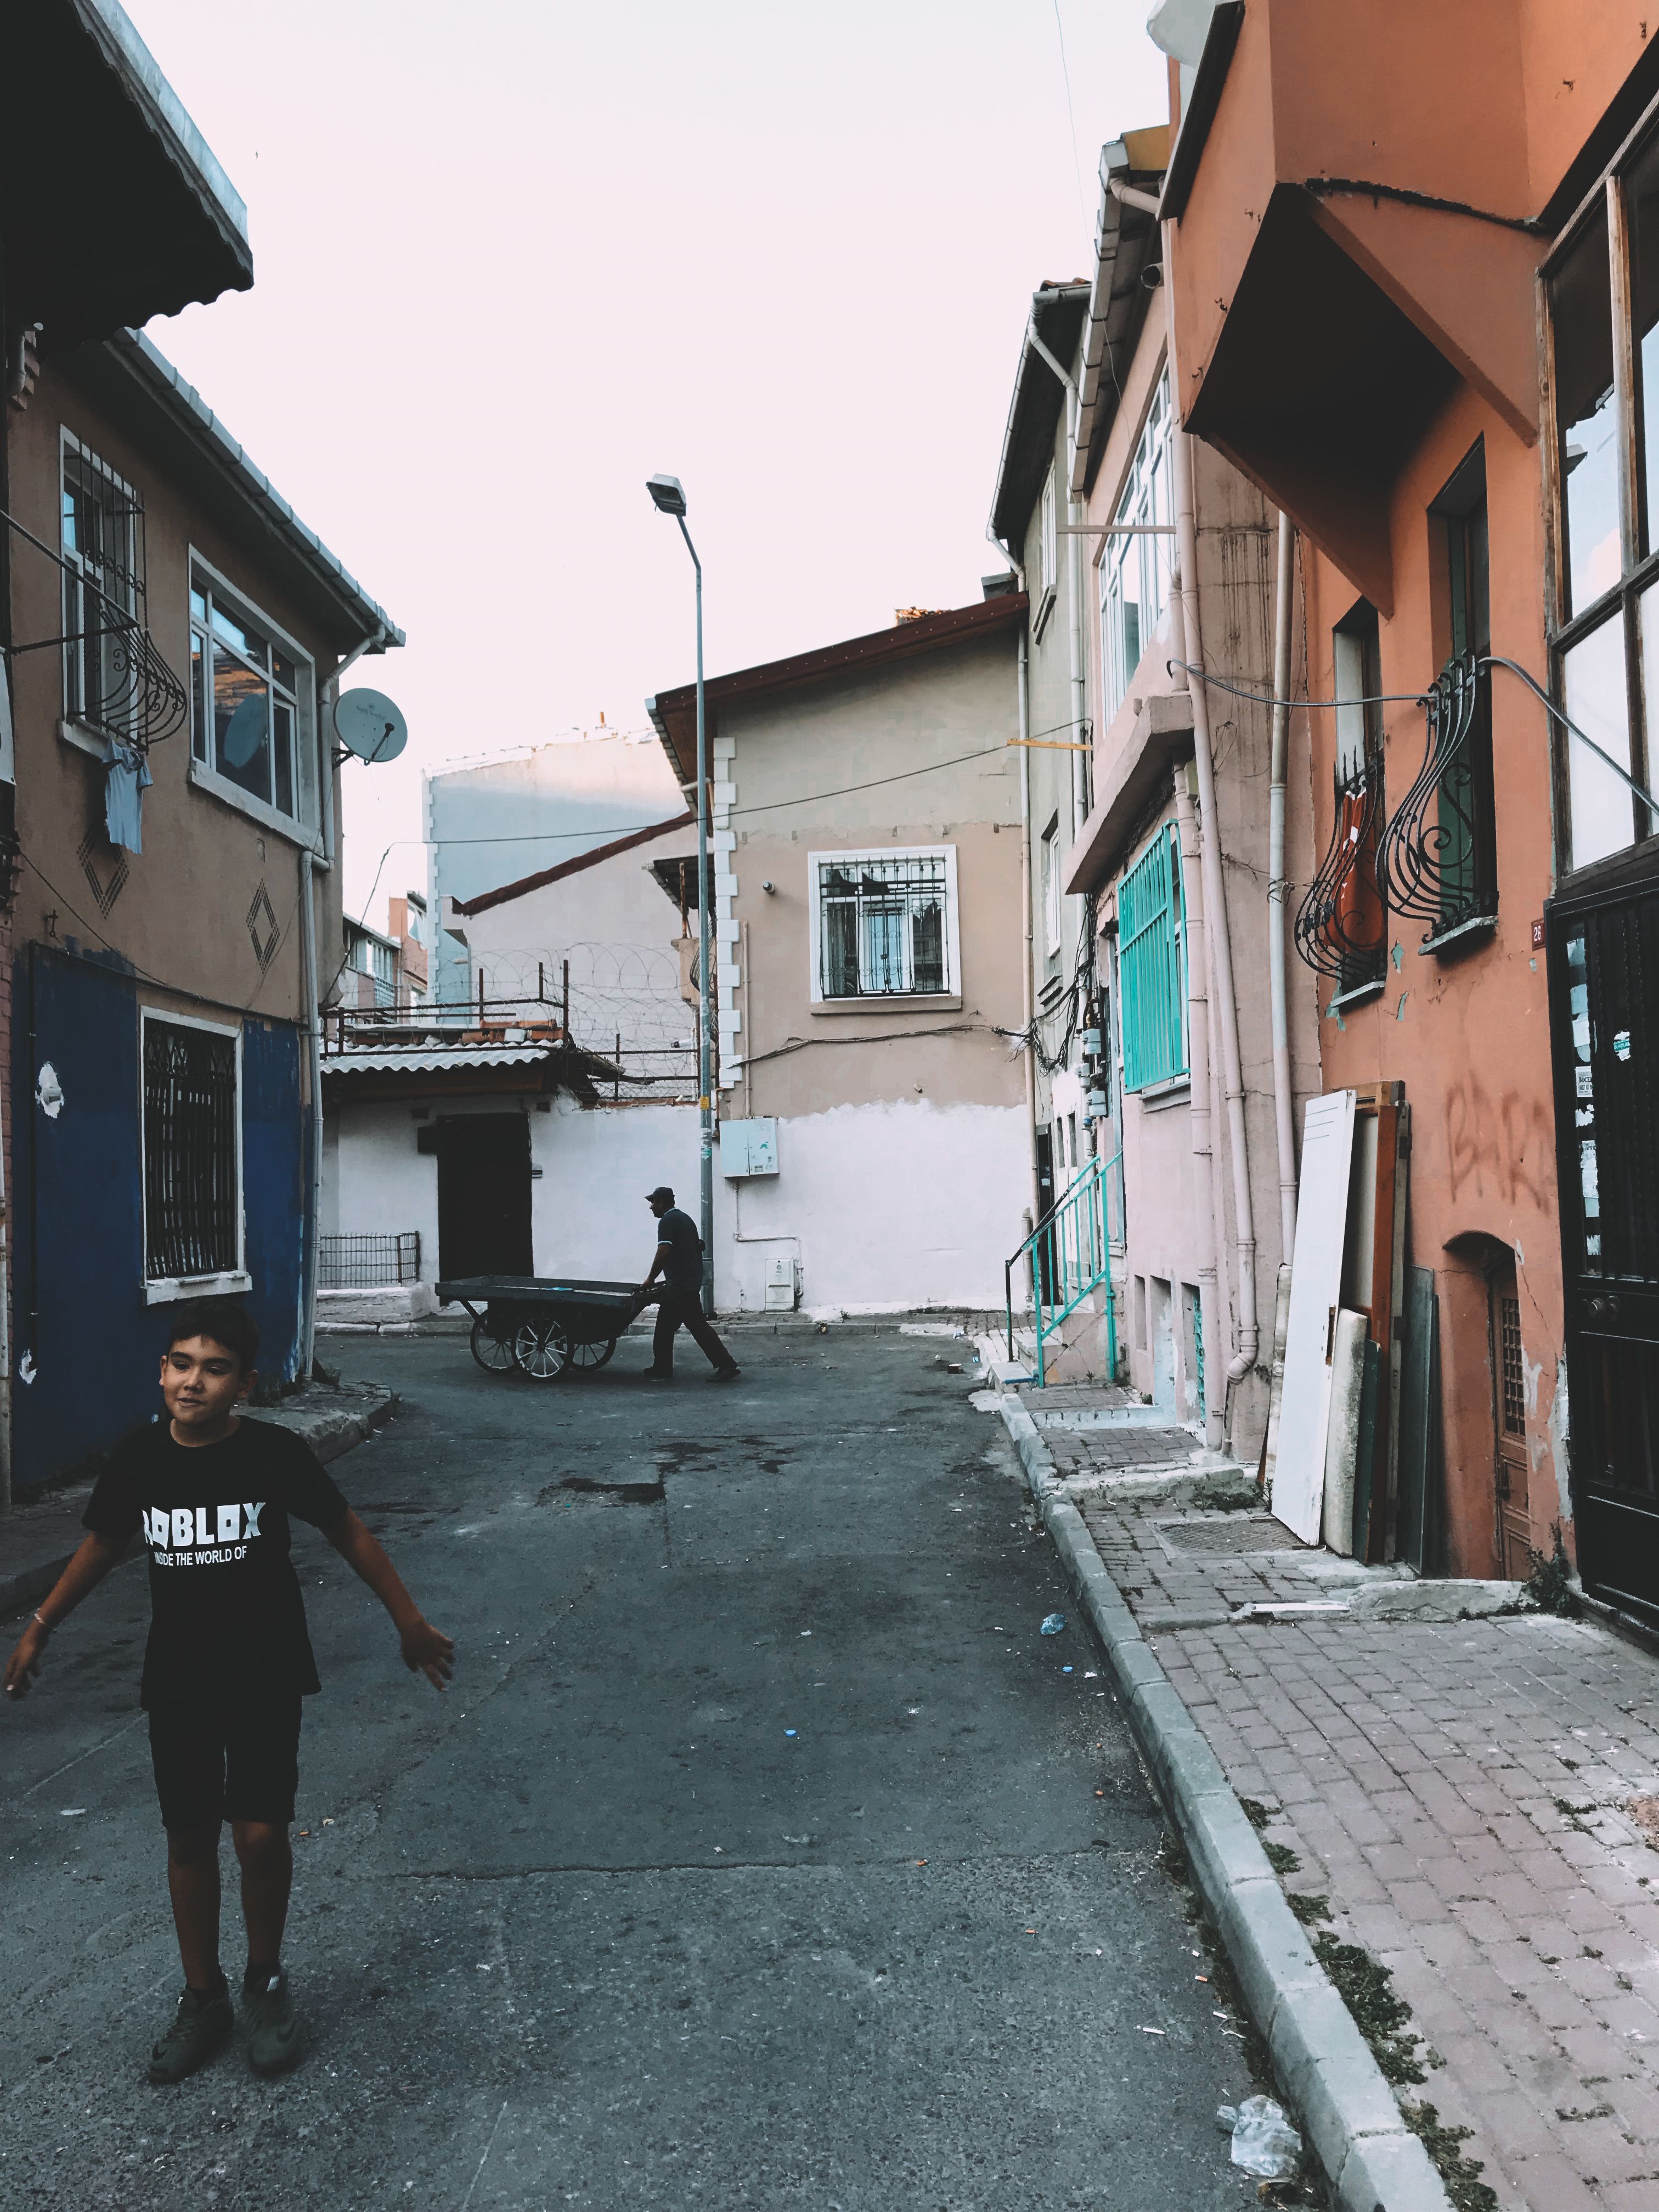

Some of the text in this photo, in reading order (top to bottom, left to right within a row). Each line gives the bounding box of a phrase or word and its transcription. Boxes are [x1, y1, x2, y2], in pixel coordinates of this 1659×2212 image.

[1534, 925, 1542, 941] 26
[176, 1553, 193, 1566] THE
[195, 1549, 232, 1565] WORLD
[234, 1545, 247, 1560] OF
